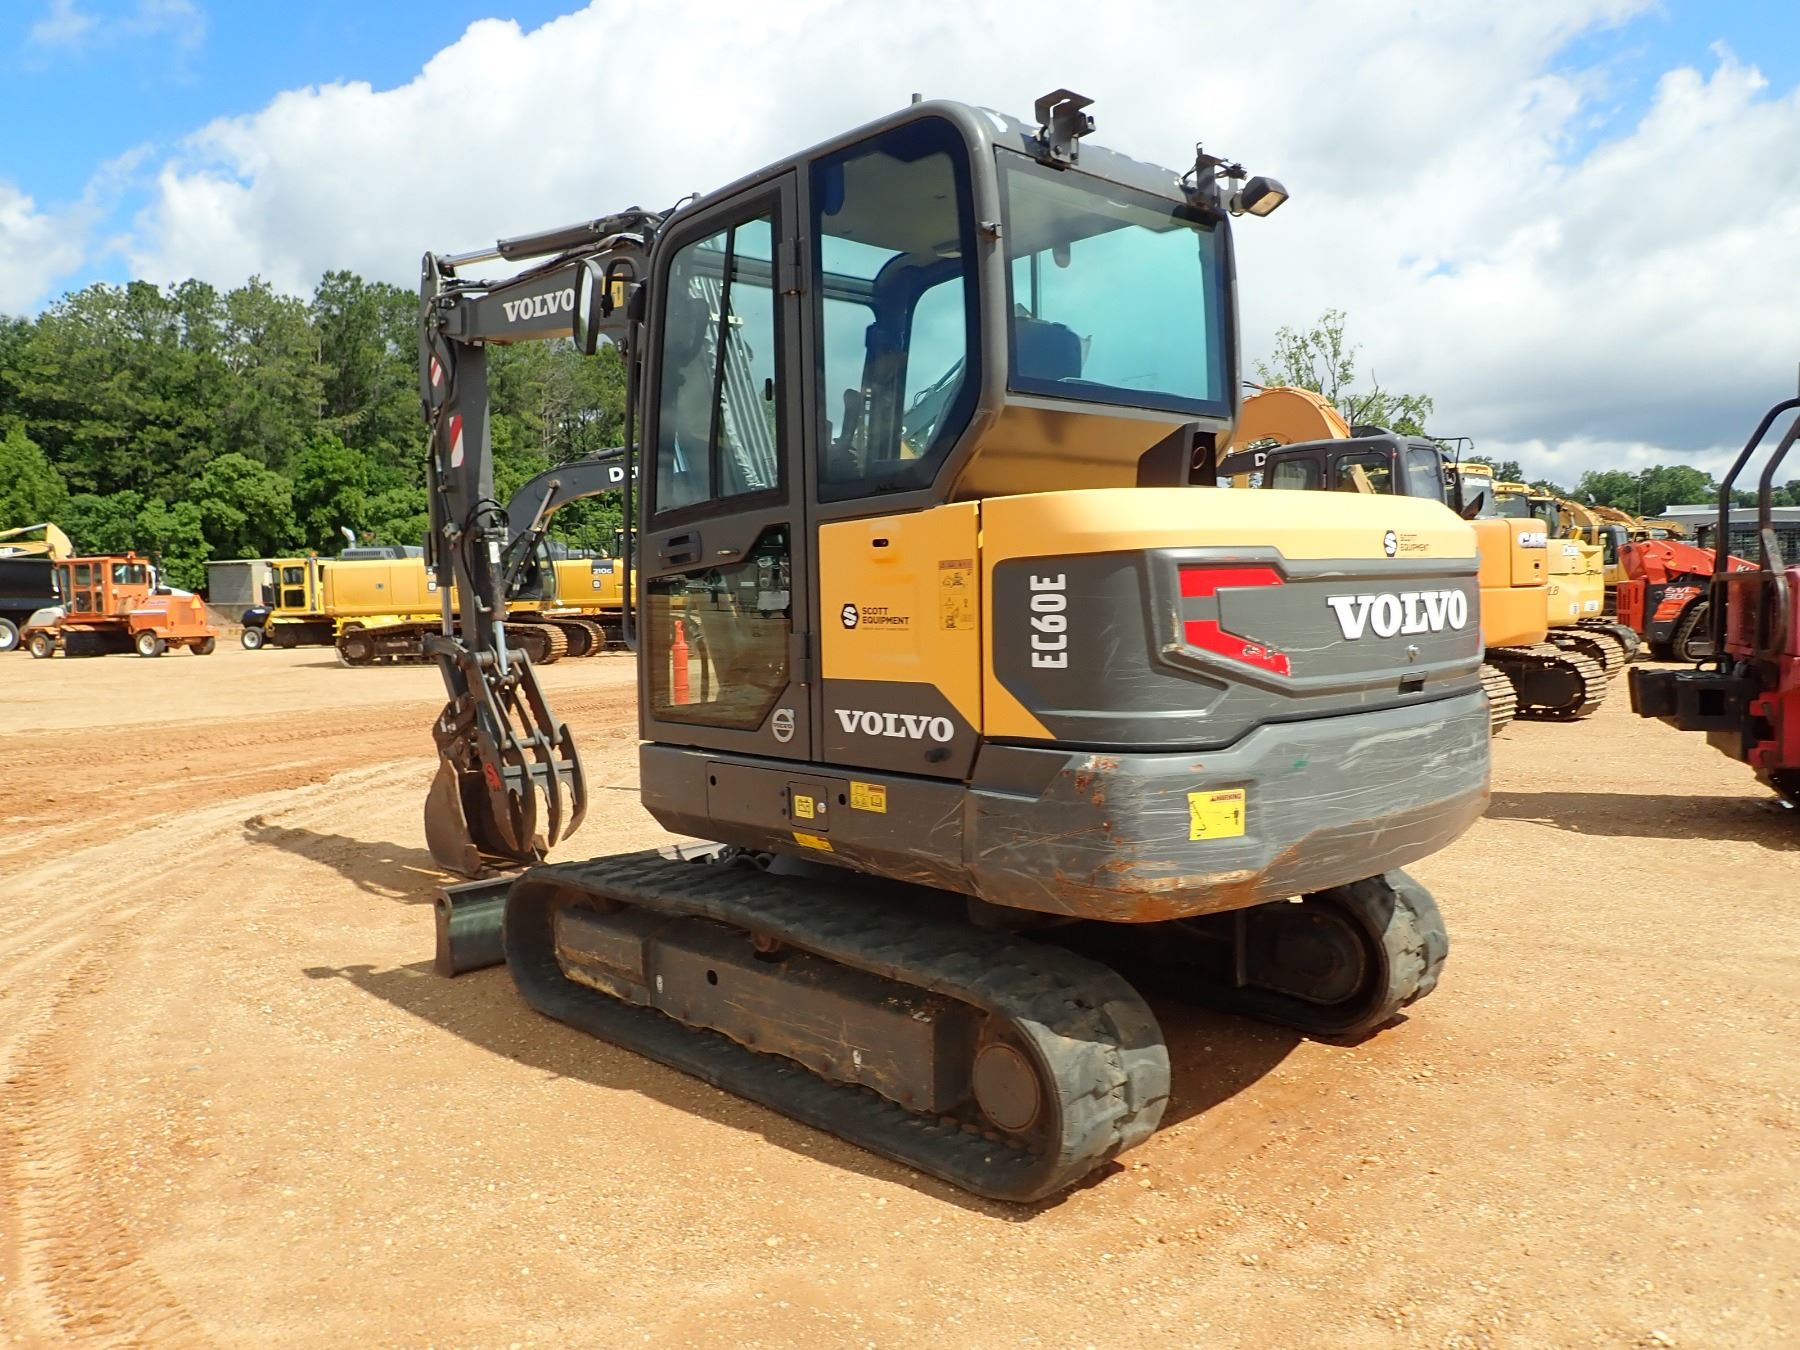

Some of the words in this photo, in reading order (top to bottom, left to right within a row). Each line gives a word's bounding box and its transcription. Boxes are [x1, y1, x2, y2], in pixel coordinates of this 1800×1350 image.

[502, 288, 575, 322] VOLVO
[862, 607, 888, 615] SCOTT
[862, 616, 910, 625] EQUIPMENT
[1029, 573, 1068, 669] EC60E
[1325, 589, 1468, 640] VOLVO
[834, 708, 955, 743] VOLVO
